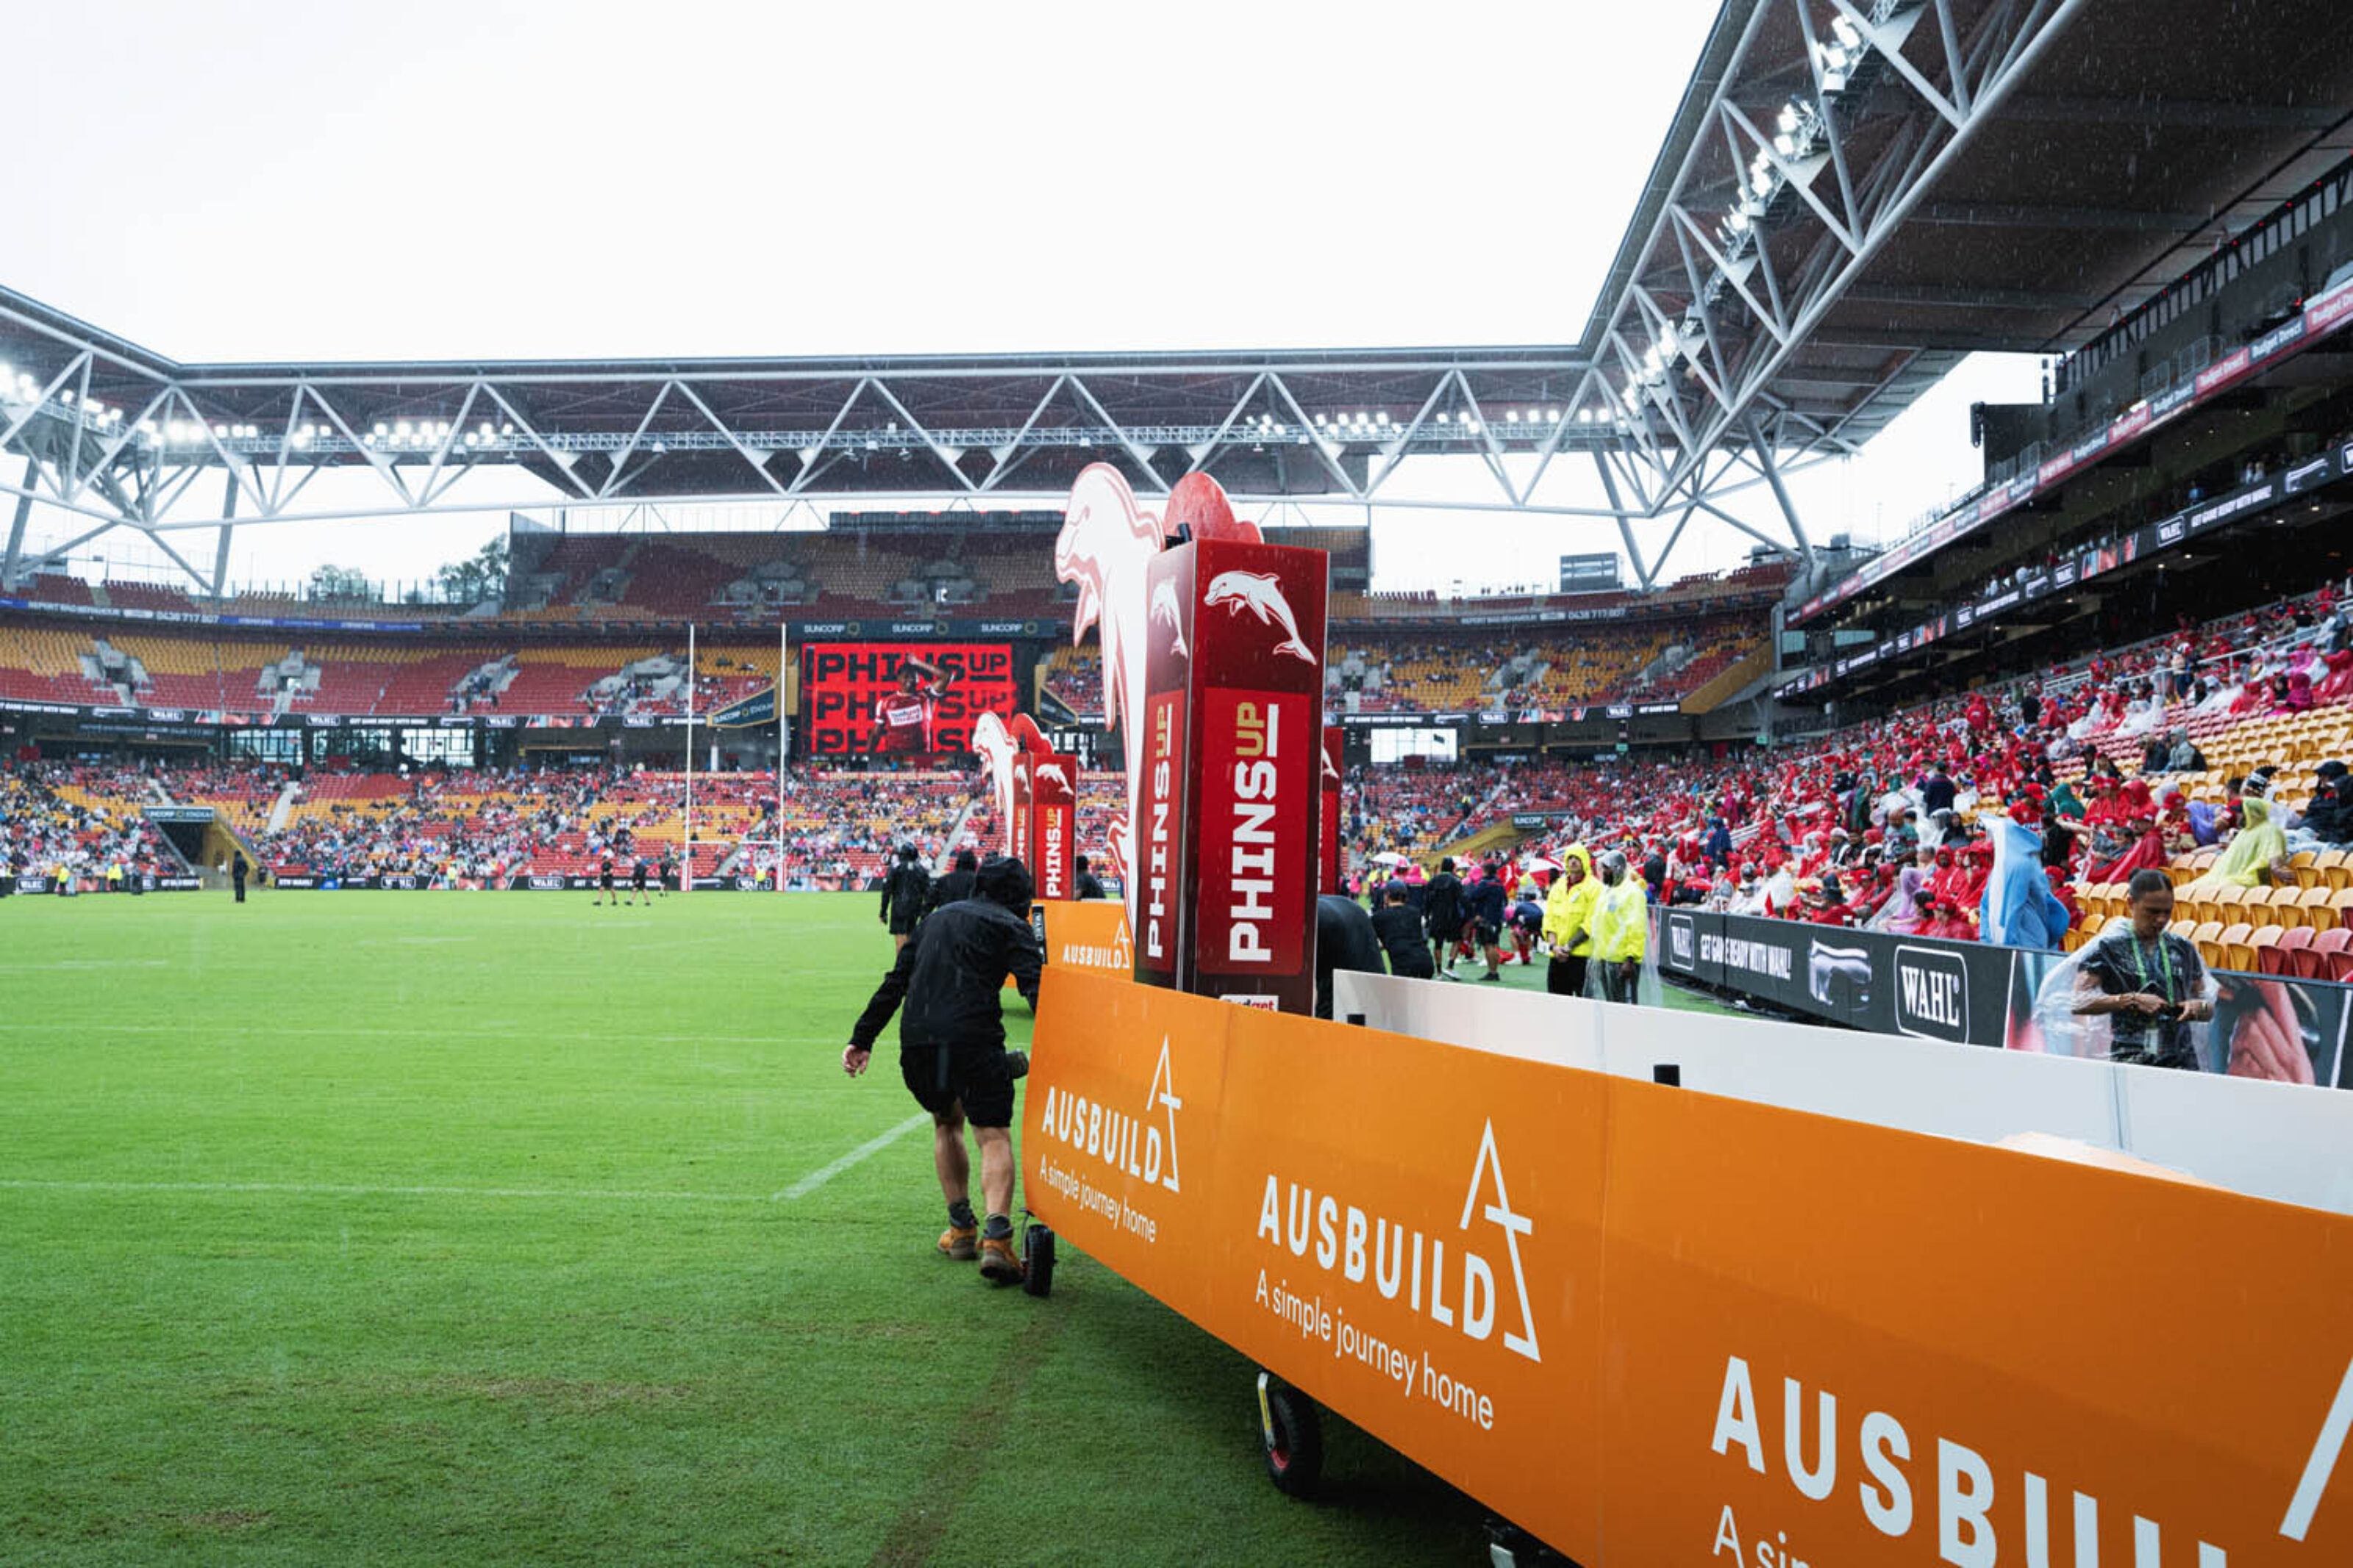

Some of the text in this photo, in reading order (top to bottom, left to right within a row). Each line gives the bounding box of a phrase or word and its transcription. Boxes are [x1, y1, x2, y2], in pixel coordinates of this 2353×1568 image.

[2252, 319, 2302, 358] Budget Direct
[804, 624, 845, 634] SUNCORP
[892, 624, 933, 633] SUNCORP
[982, 623, 1023, 632] SUNCORP
[532, 878, 561, 887] WAHL
[1063, 943, 1122, 969] AUSBUILD
[1671, 926, 1691, 959] WAHL
[1041, 1085, 1162, 1184] AUSBUILD
[1040, 1153, 1157, 1243] A simple journey home
[1257, 1174, 1496, 1341] AUSBUILD
[1256, 1268, 1494, 1430] A simple journey home
[1713, 1504, 1745, 1568] A
